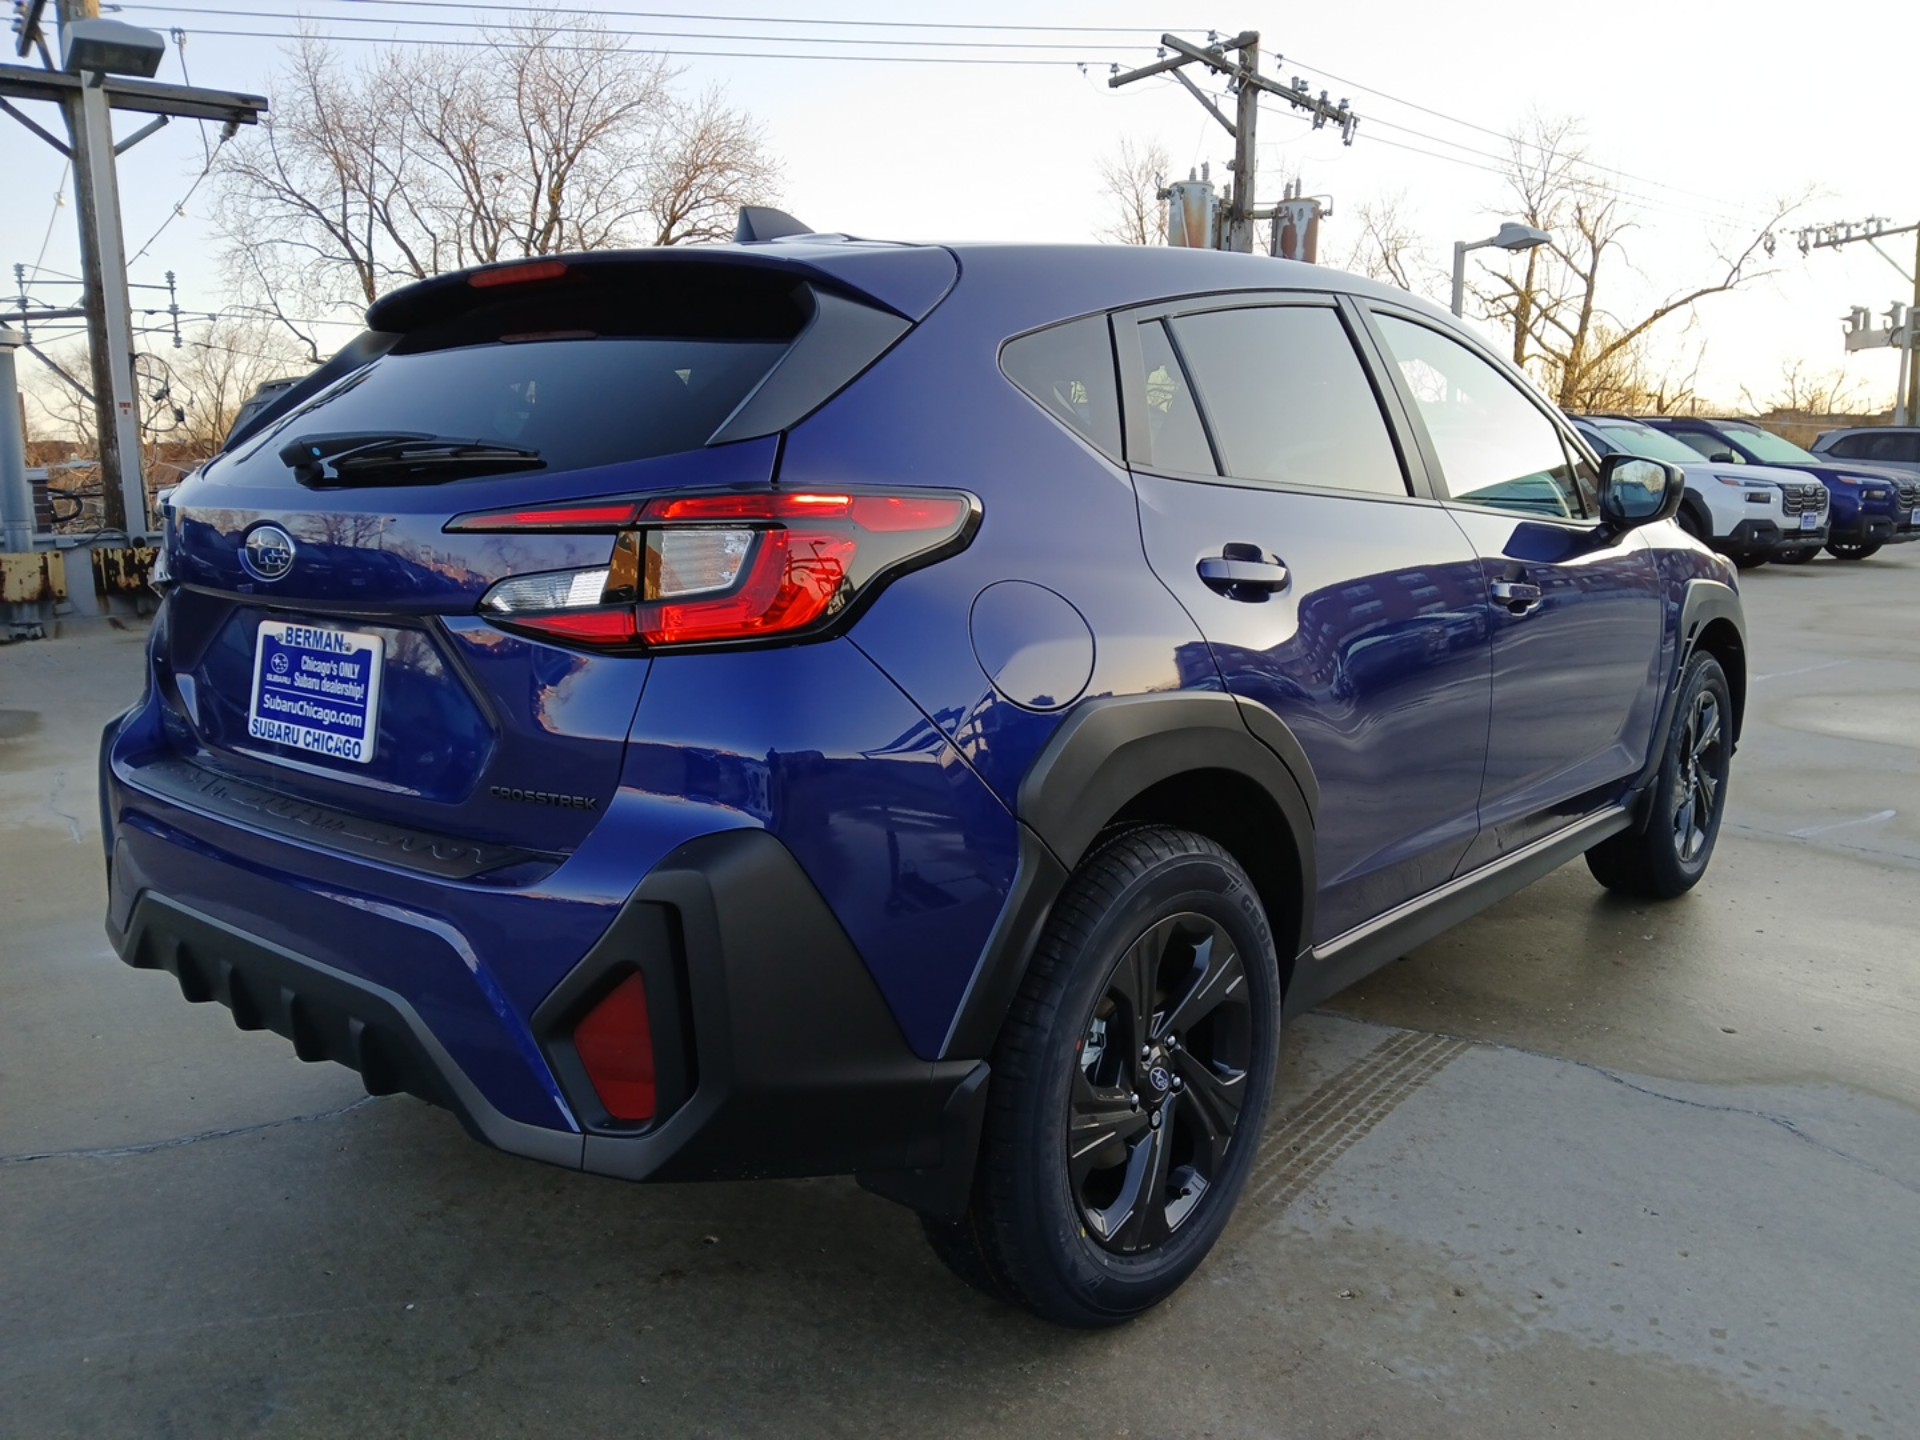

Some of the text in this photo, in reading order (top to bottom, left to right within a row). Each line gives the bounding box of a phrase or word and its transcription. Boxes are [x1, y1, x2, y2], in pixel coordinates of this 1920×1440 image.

[285, 626, 344, 652] BERMAN
[301, 655, 360, 679] Chicago's ONLY
[293, 671, 365, 701] Subaru dealership!
[263, 693, 362, 729] SubaruChicago.com
[251, 718, 362, 759] SUBARU CHICAGO
[490, 785, 597, 810] CROSSTREK
